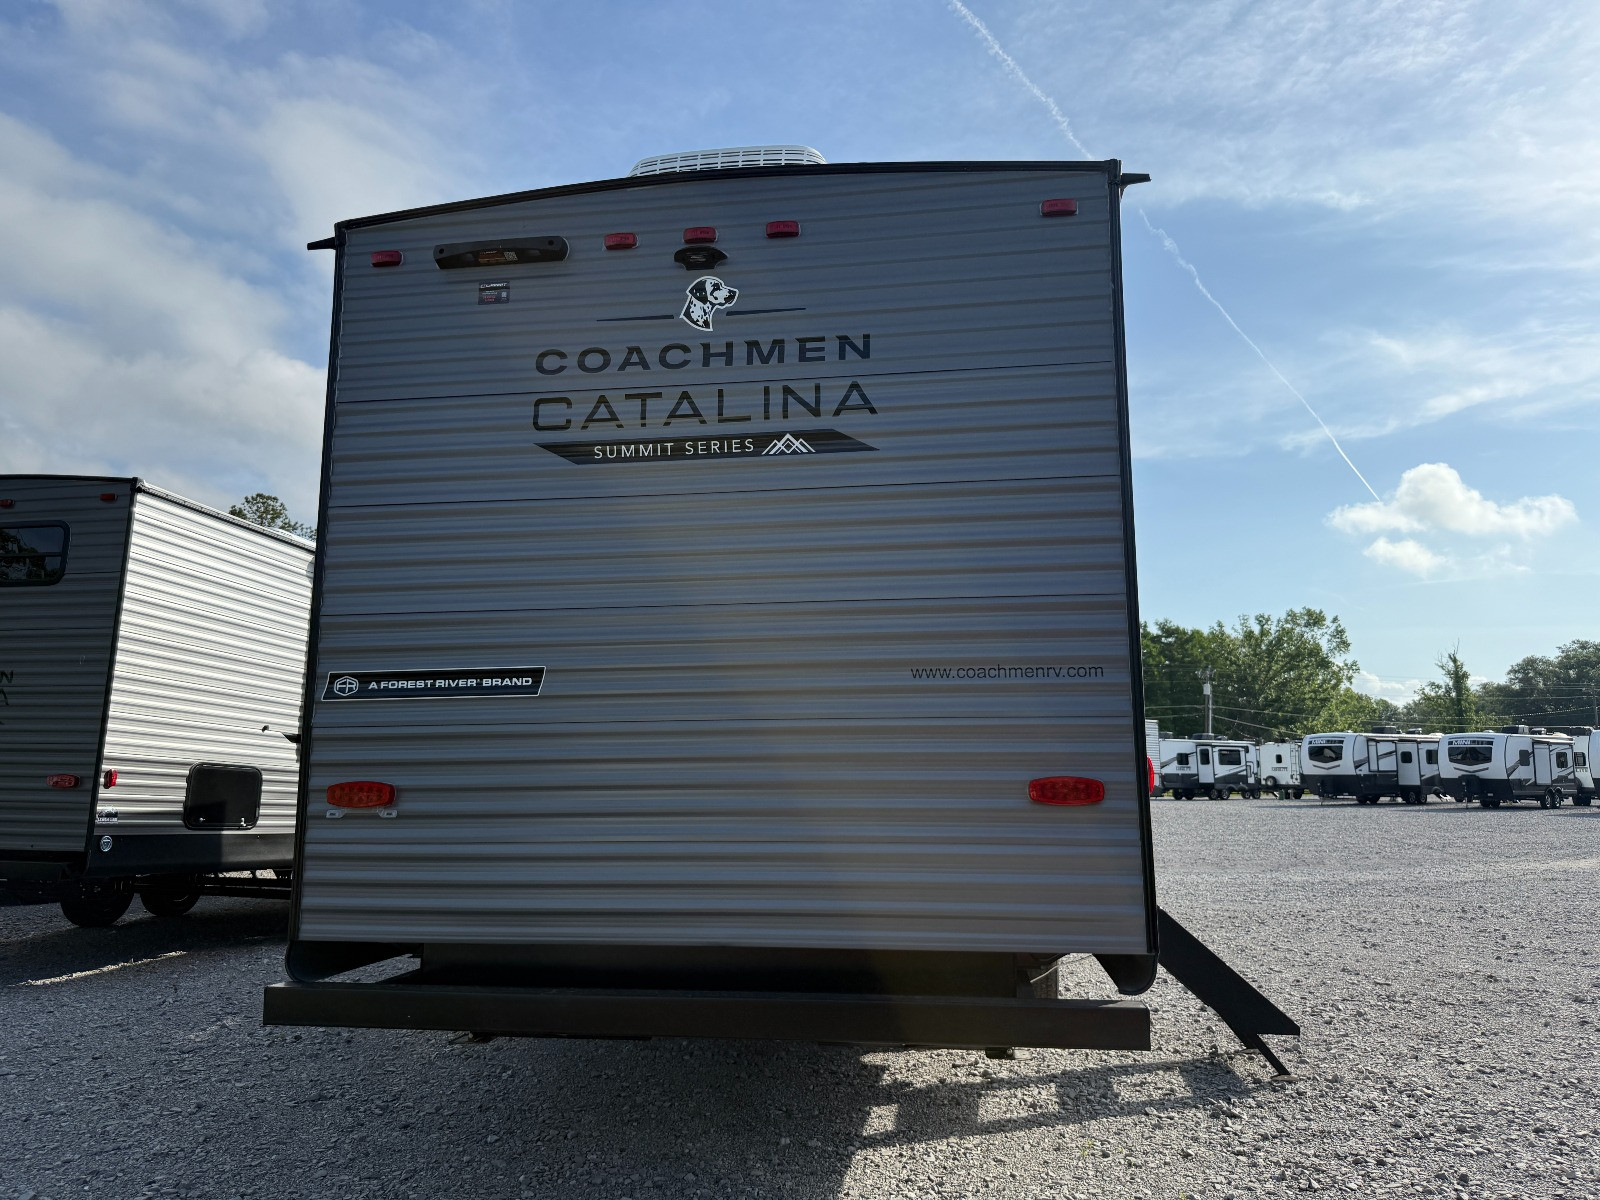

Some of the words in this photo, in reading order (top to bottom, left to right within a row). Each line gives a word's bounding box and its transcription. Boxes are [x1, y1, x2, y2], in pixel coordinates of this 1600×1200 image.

[535, 333, 871, 376] COACHMEN
[532, 380, 879, 432] CATALINA
[593, 442, 674, 459] SUMMIT
[685, 438, 755, 455] SERIES
[910, 663, 1105, 680] www.coachmenrv.com
[368, 681, 379, 690] A
[380, 680, 433, 690] FOREST
[482, 677, 533, 687] BRAND
